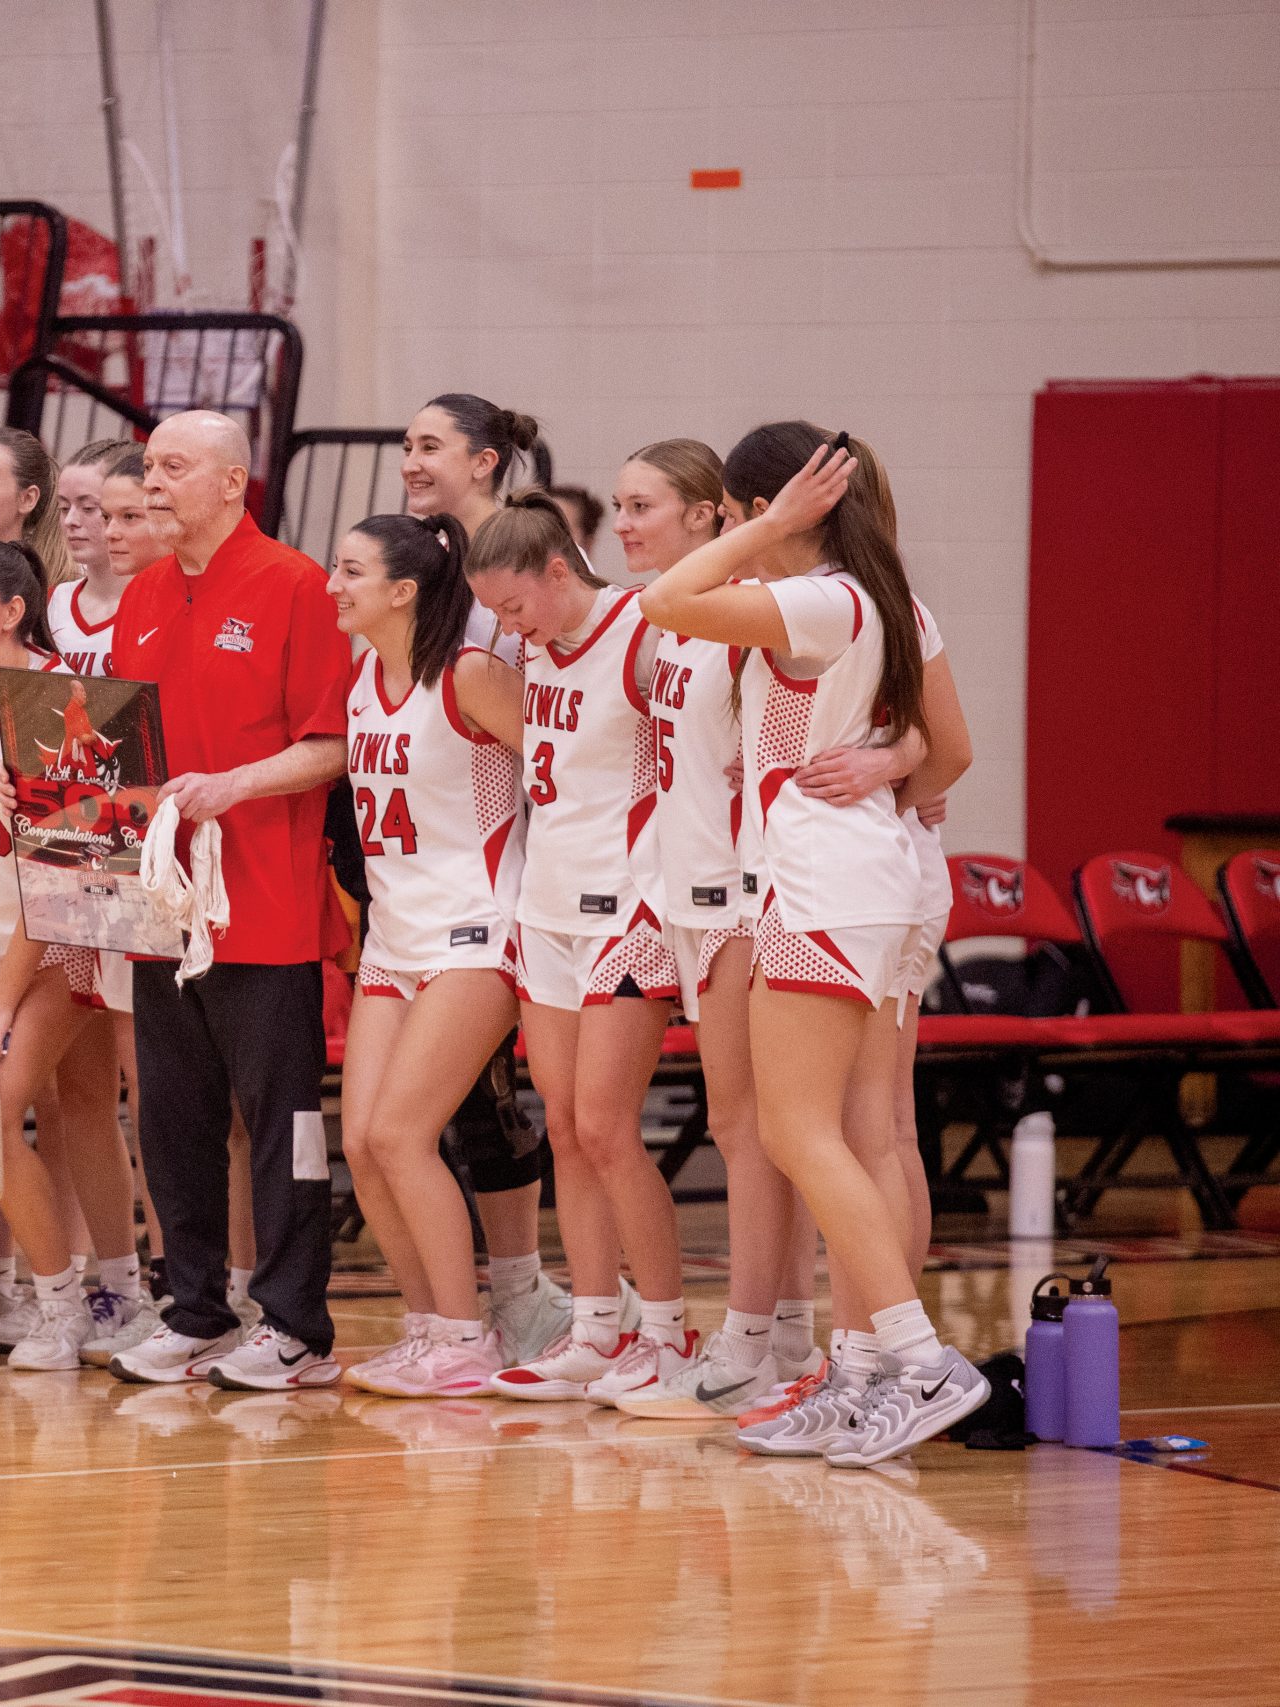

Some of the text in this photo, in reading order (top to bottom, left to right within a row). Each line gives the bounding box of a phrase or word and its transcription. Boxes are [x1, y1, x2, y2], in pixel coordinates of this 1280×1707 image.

[524, 682, 583, 732] OWLS
[350, 732, 411, 775] OWLS
[529, 741, 557, 807] 3
[14, 813, 146, 848] Congratulations, Co
[16, 777, 158, 834] 500
[356, 787, 418, 857] 24
[474, 930, 483, 938] M
